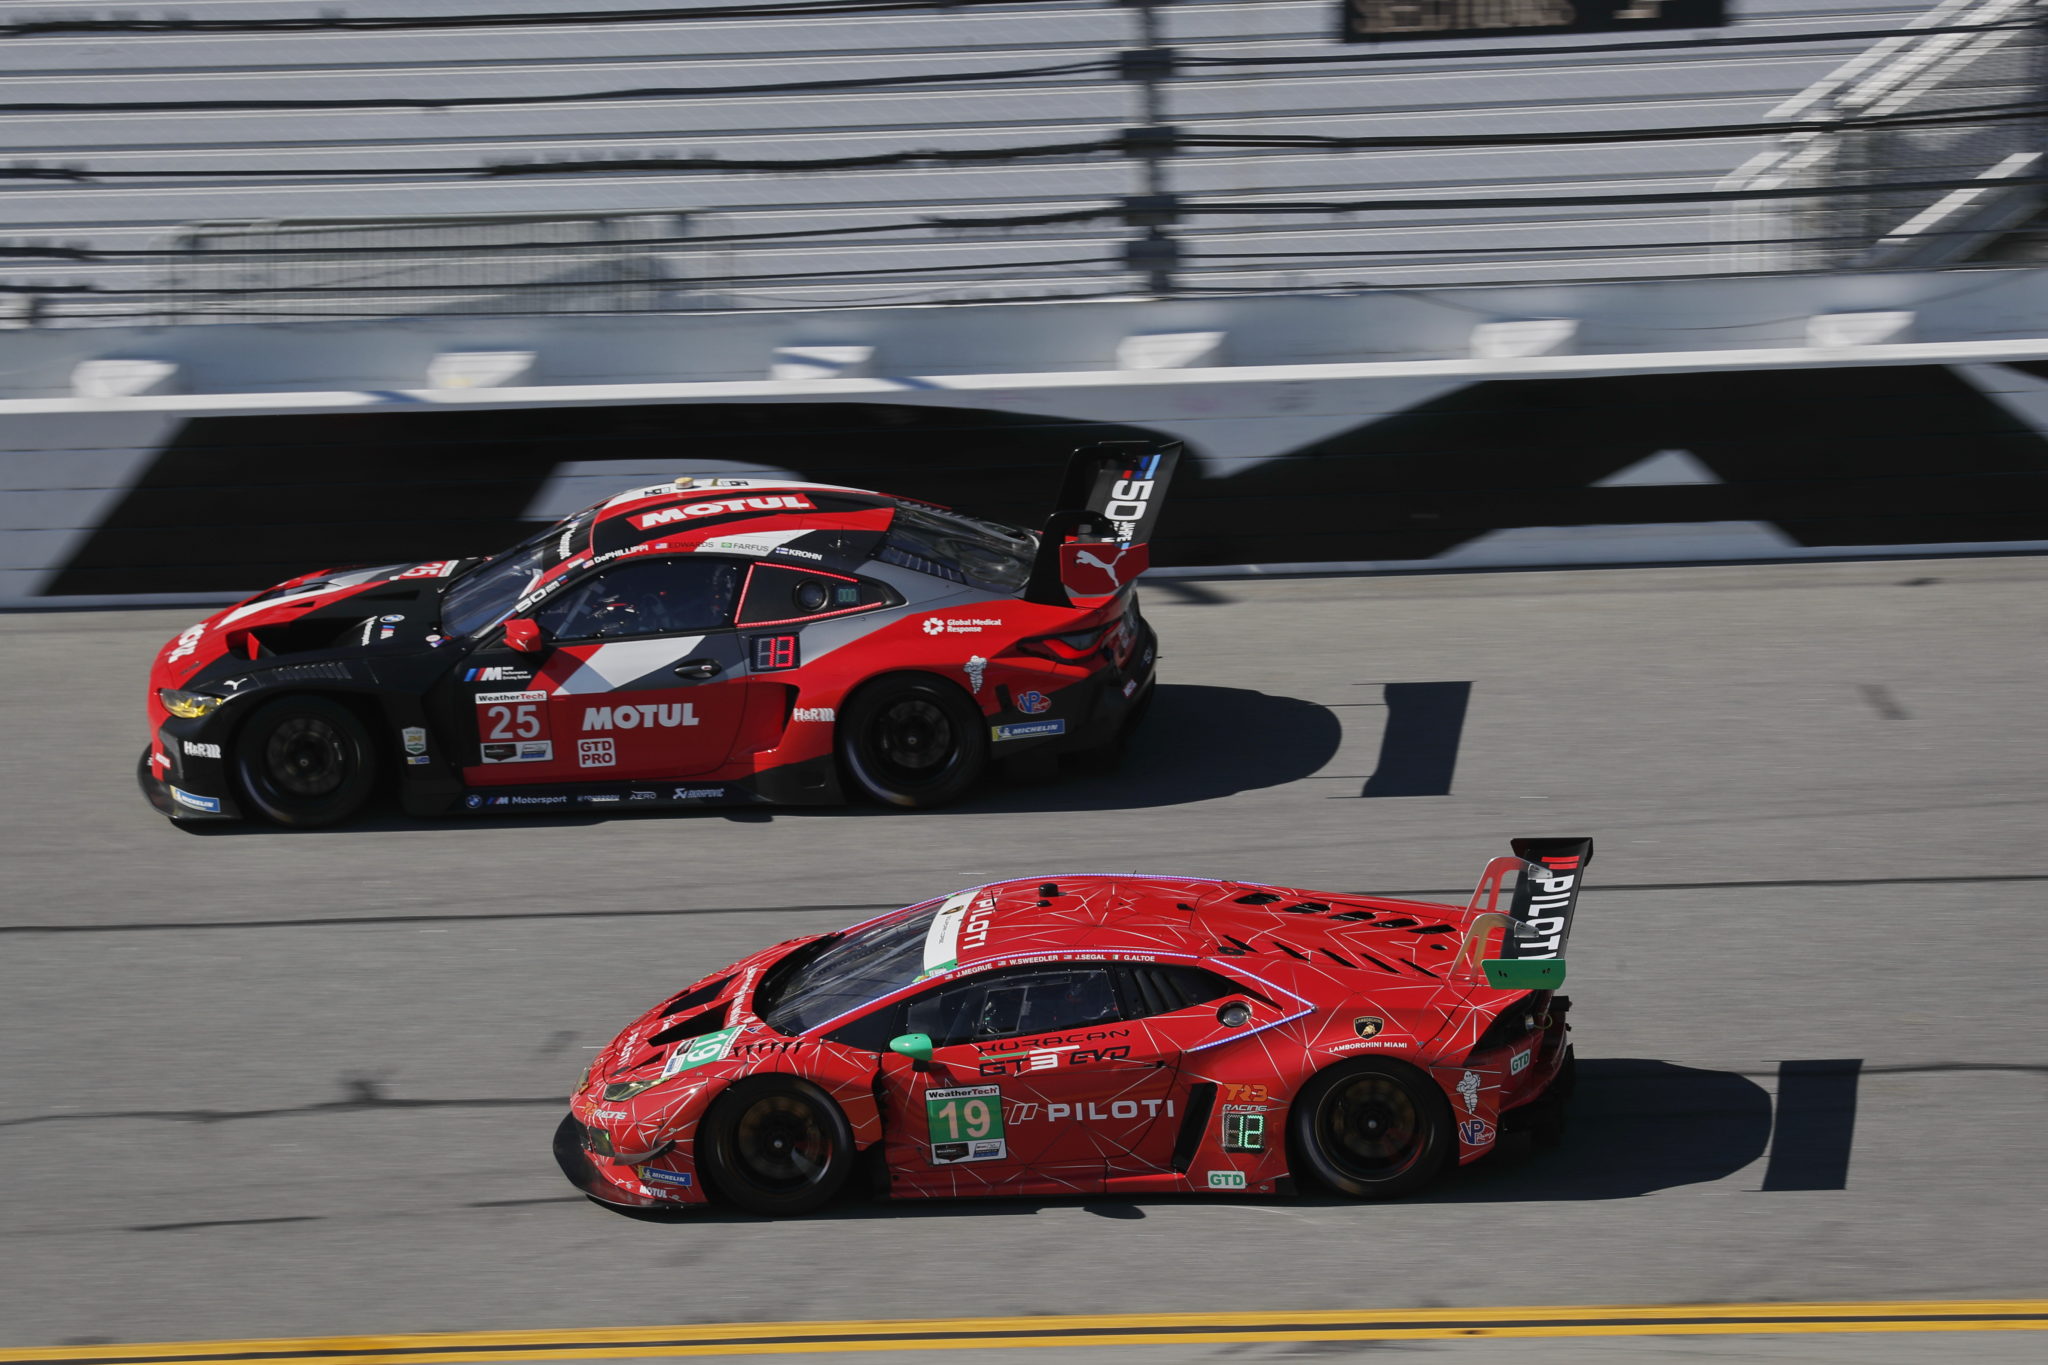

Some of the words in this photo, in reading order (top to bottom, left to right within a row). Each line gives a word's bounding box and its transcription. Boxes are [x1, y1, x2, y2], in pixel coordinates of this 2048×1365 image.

[641, 496, 810, 528] MOTUL
[668, 541, 714, 549] EDWARDS
[733, 543, 769, 552] FARFUS
[594, 543, 649, 564] DePHILLIPPI
[788, 548, 822, 561] KROHN
[947, 619, 970, 627] Global
[973, 619, 1002, 627] Medical
[947, 626, 982, 634] Response
[479, 693, 544, 702] WeatherTech
[1018, 690, 1041, 713] VP
[488, 705, 540, 739] 25
[582, 703, 699, 731] MOTUL
[1012, 724, 1058, 735] MICHELIN
[580, 740, 613, 753] GTD
[581, 752, 613, 765] PRO
[512, 795, 567, 804] Motorsport
[963, 897, 998, 950] PILOTI
[1518, 875, 1575, 960] PILOTI
[1009, 955, 1059, 966] W.SWEEDLER
[956, 963, 993, 978] J.MEGRUE
[978, 1029, 1130, 1053] HURACAN
[1328, 1041, 1382, 1053] LAMBORGHINI
[1383, 1041, 1408, 1049] MIAMI
[979, 1053, 1059, 1077] GT3
[1069, 1046, 1131, 1065] EVO
[1511, 1053, 1530, 1072] GTD
[928, 1087, 998, 1098] WeatherTech
[1048, 1099, 1175, 1122] PILOTI
[1222, 1104, 1268, 1112] RACING
[939, 1099, 991, 1139] 19
[1460, 1119, 1485, 1145] VP
[651, 1172, 686, 1182] MICHELIN
[1209, 1174, 1244, 1186] GTD
[640, 1185, 668, 1199] MOTUL
